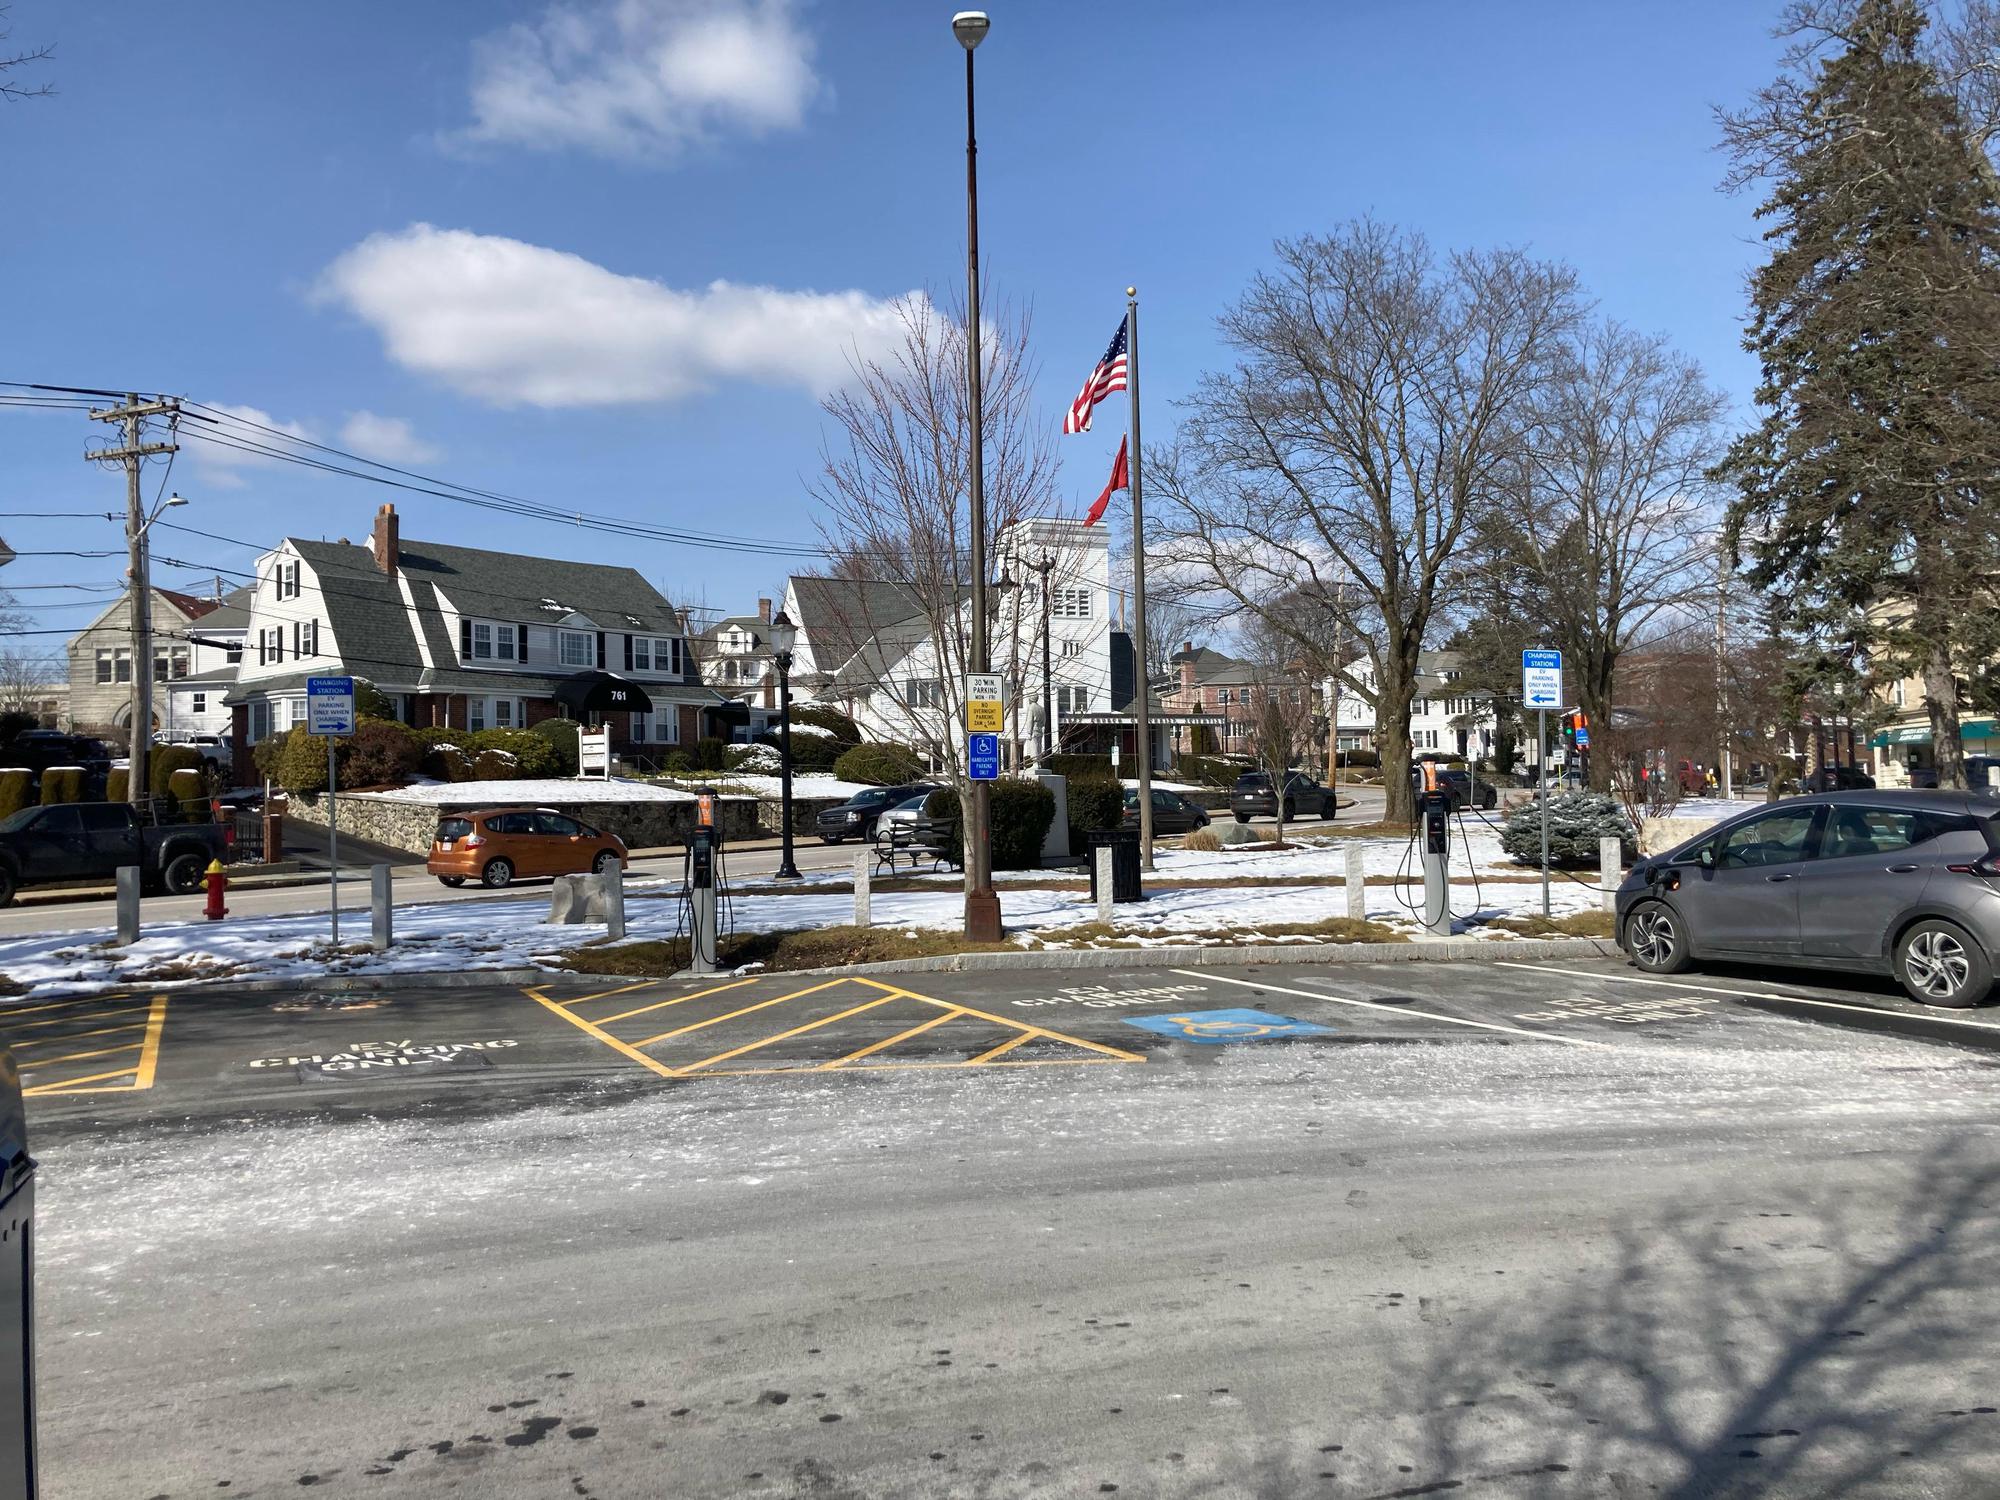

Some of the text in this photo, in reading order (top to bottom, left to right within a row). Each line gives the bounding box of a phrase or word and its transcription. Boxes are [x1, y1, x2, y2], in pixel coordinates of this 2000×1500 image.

[611, 690, 627, 701] 761
[972, 686, 998, 694] PARKING
[1011, 984, 1208, 1007] CHARGING
[1058, 985, 1110, 995] EV
[1082, 993, 1184, 1008] ONLY
[1545, 997, 1606, 1007] EV
[1514, 997, 1720, 1020] CHARGING
[1602, 1006, 1715, 1023] ONLY
[350, 1039, 412, 1051] EV
[250, 1039, 519, 1068] CHARGING
[322, 1052, 458, 1071] ONLY
